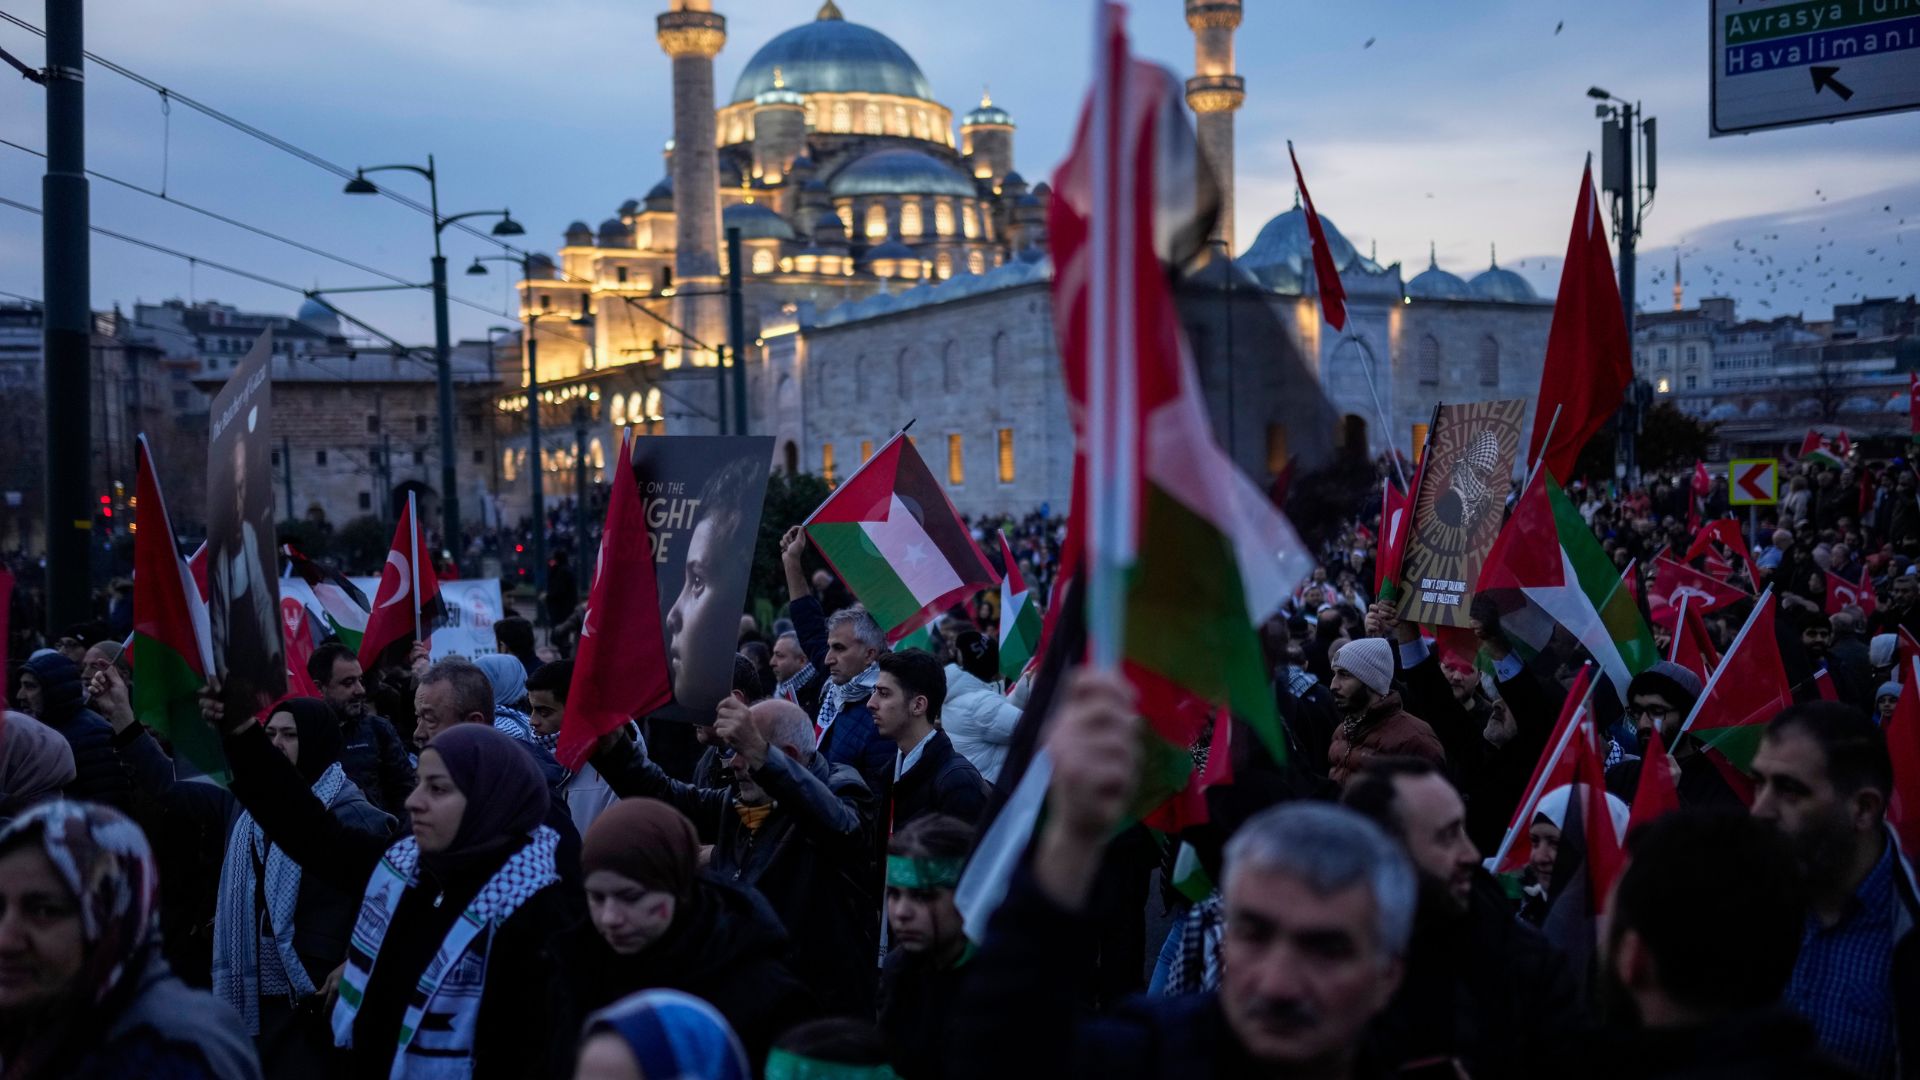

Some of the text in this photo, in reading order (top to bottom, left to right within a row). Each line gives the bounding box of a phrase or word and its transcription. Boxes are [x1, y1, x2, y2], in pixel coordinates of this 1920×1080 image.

[1728, 4, 1842, 37] Avrasya
[1728, 28, 1914, 73] Havalimanı
[646, 481, 663, 495] ON
[667, 482, 685, 495] THE
[643, 498, 701, 530] IGHT
[1421, 578, 1467, 592] DON'T STOP TALKING
[1422, 591, 1460, 605] ABOUT PALESTINE
